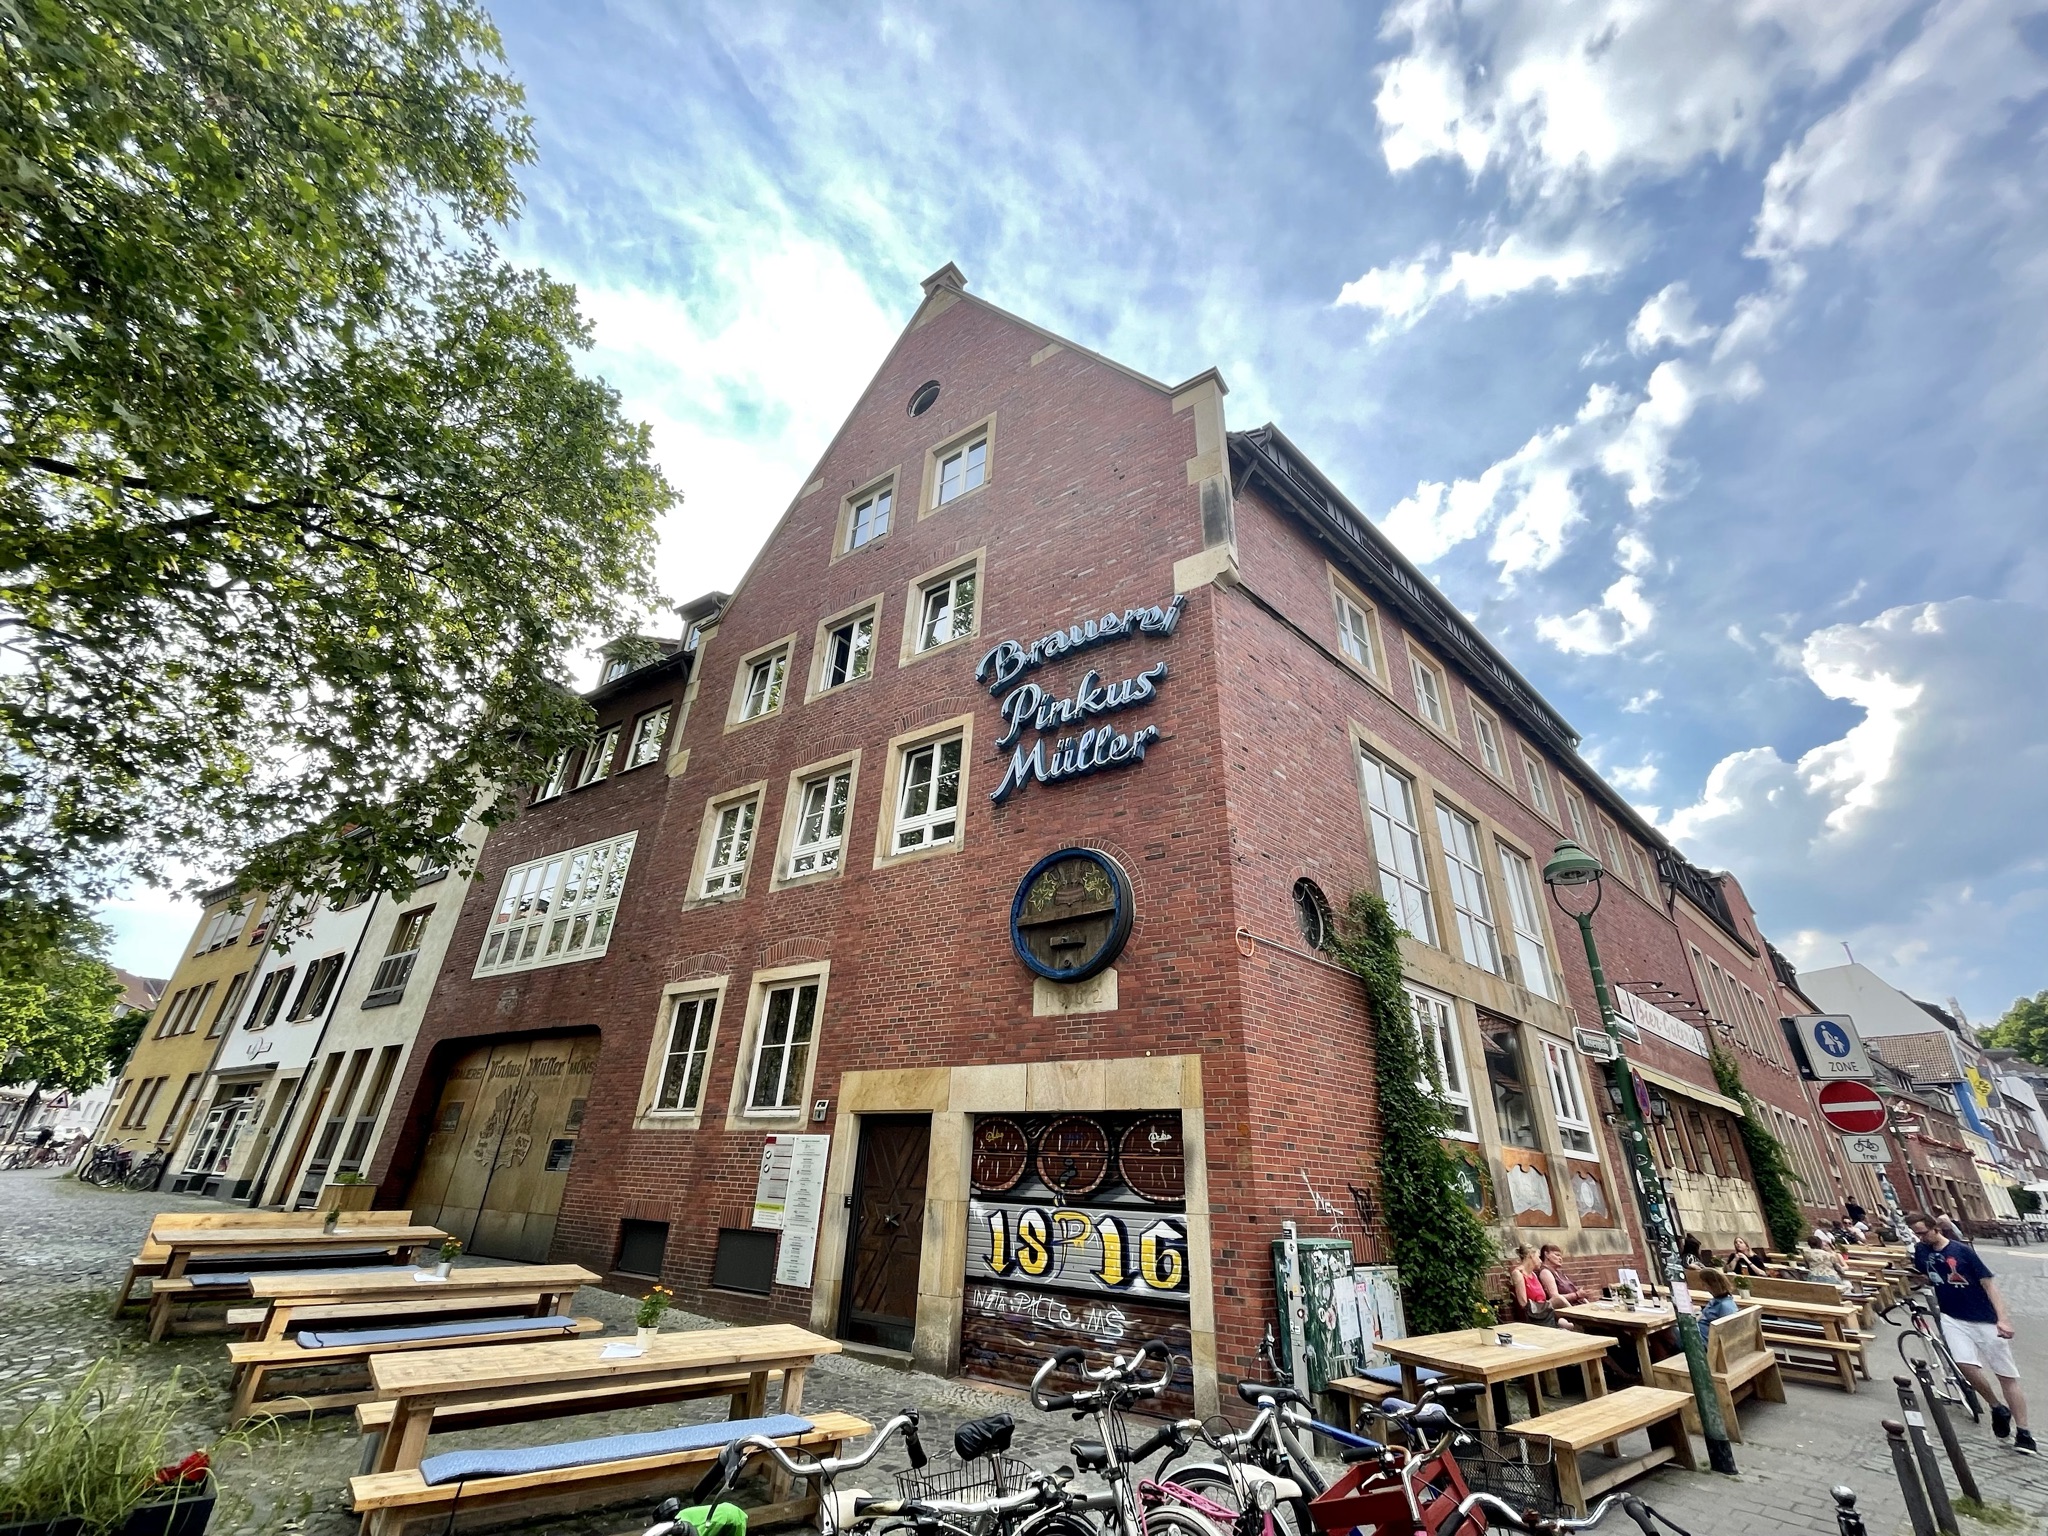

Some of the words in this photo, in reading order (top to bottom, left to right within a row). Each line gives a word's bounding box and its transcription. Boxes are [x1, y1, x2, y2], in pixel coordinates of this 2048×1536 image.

[975, 594, 1187, 698] Brauerei
[994, 661, 1168, 748] Pinkus
[989, 723, 1160, 804] Müller
[1828, 1061, 1859, 1072] ZONE
